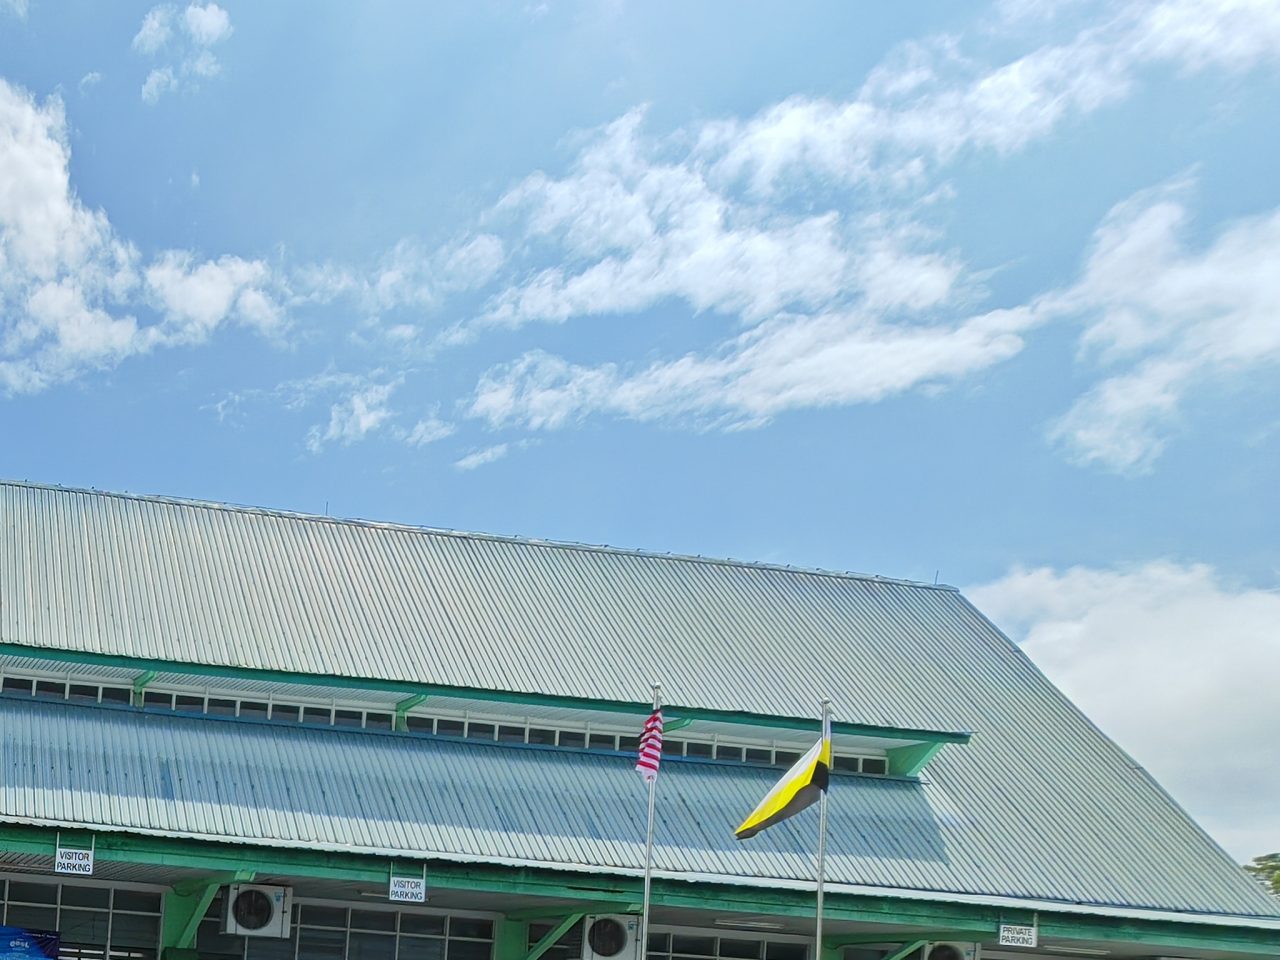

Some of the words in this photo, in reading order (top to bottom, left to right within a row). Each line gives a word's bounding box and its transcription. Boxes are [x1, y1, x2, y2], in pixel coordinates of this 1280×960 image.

[60, 851, 90, 861] VISITOR
[57, 862, 91, 872] PARKING
[393, 879, 421, 890] VISITOR
[391, 890, 422, 901] PARKING
[1002, 926, 1033, 937] PRIVATE
[1001, 935, 1033, 946] PARKING
